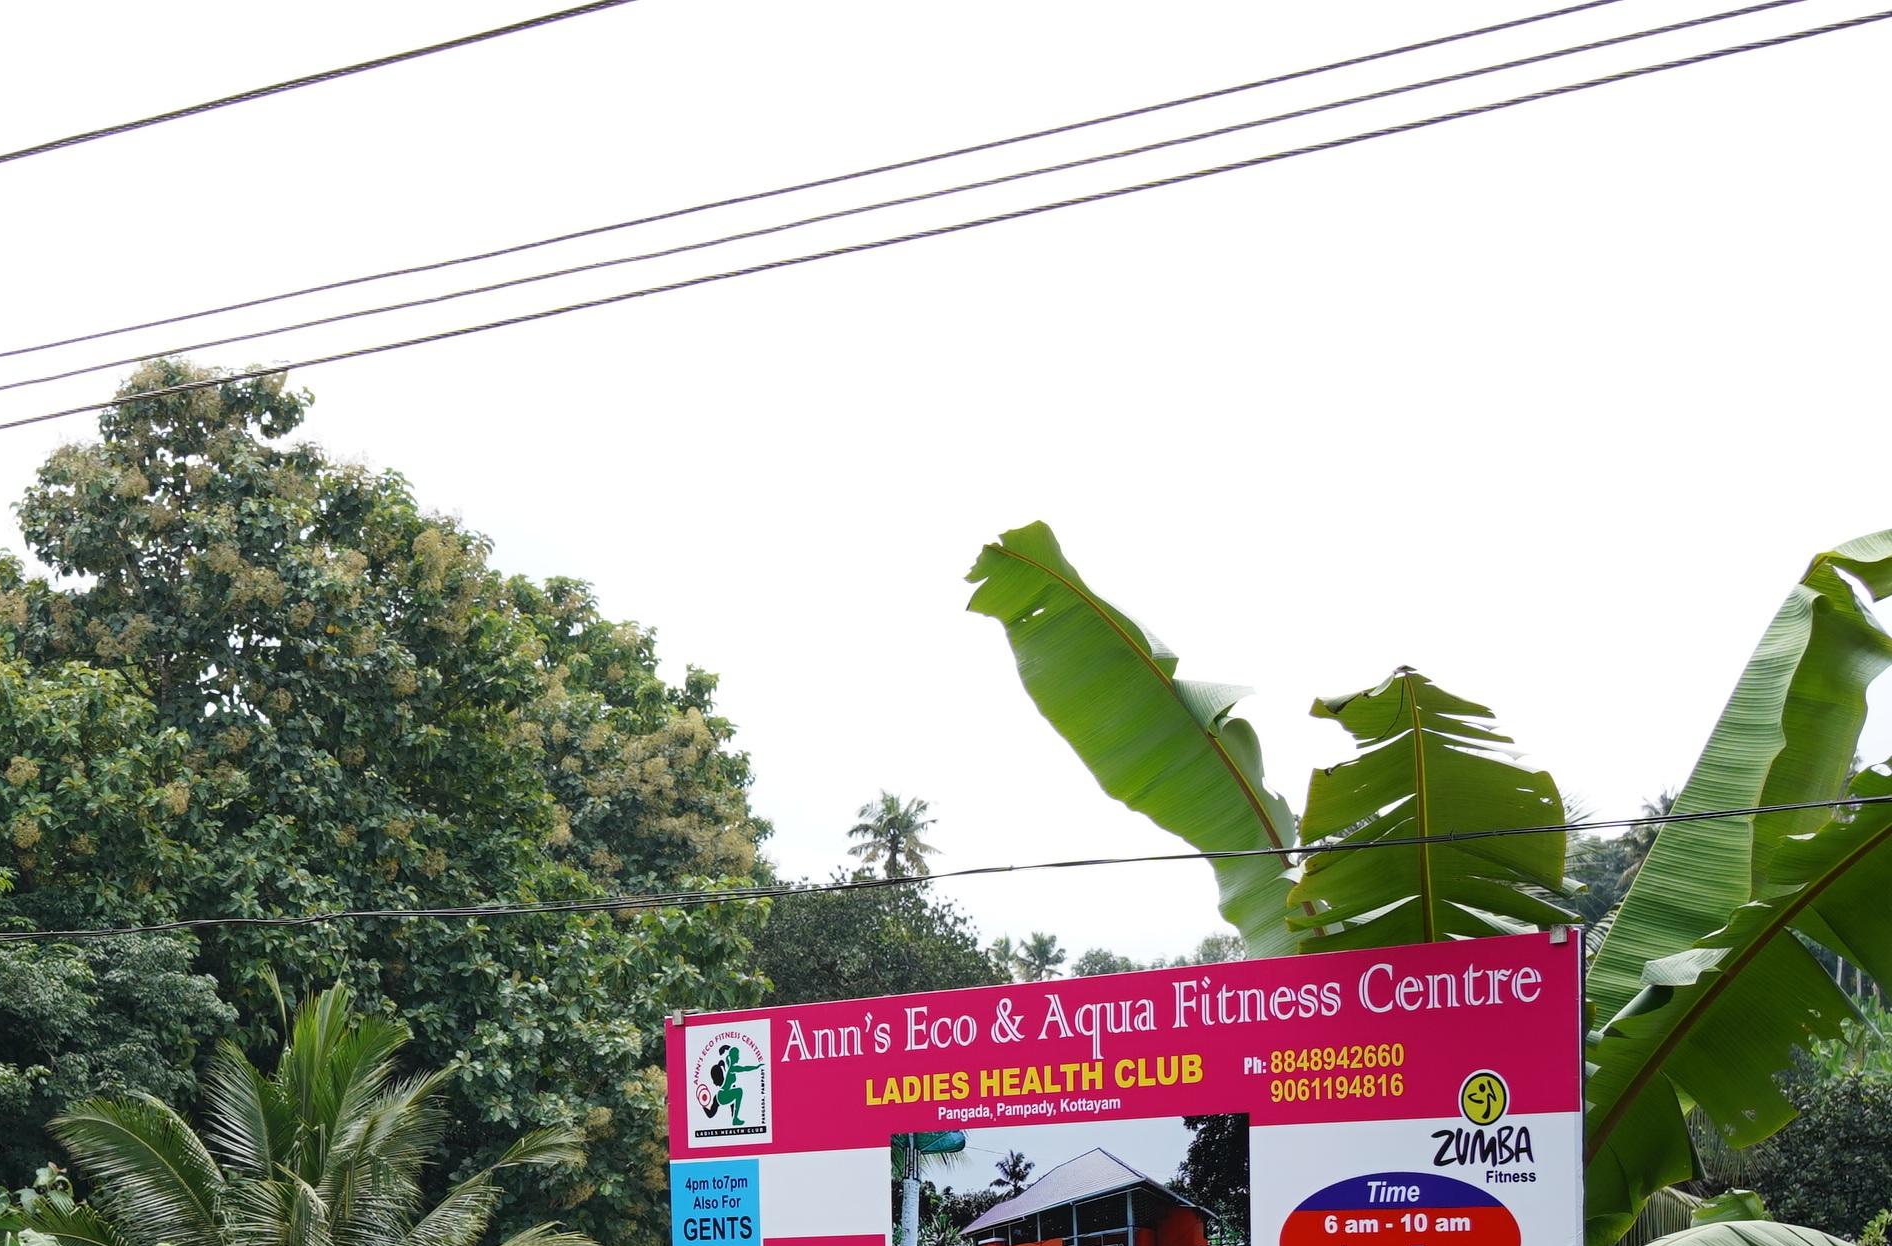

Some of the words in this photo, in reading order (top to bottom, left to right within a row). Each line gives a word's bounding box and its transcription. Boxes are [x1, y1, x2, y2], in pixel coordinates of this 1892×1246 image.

[781, 1012, 891, 1062] Ann's
[904, 1006, 977, 1051] Eco
[991, 998, 1025, 1043] &
[1038, 994, 1158, 1060] Aqua
[1172, 975, 1341, 1030] Fitness
[1358, 962, 1542, 1013] Centre
[702, 1040, 715, 1056] ECO
[715, 1031, 741, 1043] FITNESS
[741, 1035, 765, 1062] CENTRE
[1243, 1056, 1267, 1075] Ph:
[1270, 1043, 1404, 1074] 8848942660
[866, 1072, 969, 1106] LADIES
[980, 1061, 1103, 1097] HEALTH
[1115, 1053, 1204, 1088] CLUB
[1270, 1072, 1404, 1103] 9061194816
[938, 1103, 994, 1121] Pangada,
[996, 1100, 1057, 1119] Pampady,
[1060, 1096, 1121, 1114] Kottayam
[1430, 1125, 1535, 1168] ZUMBA
[685, 1177, 709, 1192] 4pm
[1486, 1169, 1537, 1184] Fitness
[693, 1197, 718, 1210] Also
[722, 1195, 740, 1208] For
[1367, 1181, 1420, 1203] Time
[683, 1216, 752, 1241] GENTS
[1324, 1216, 1338, 1234] 6
[1345, 1219, 1379, 1233] am
[1401, 1214, 1428, 1232] 10
[1435, 1217, 1470, 1232] am
